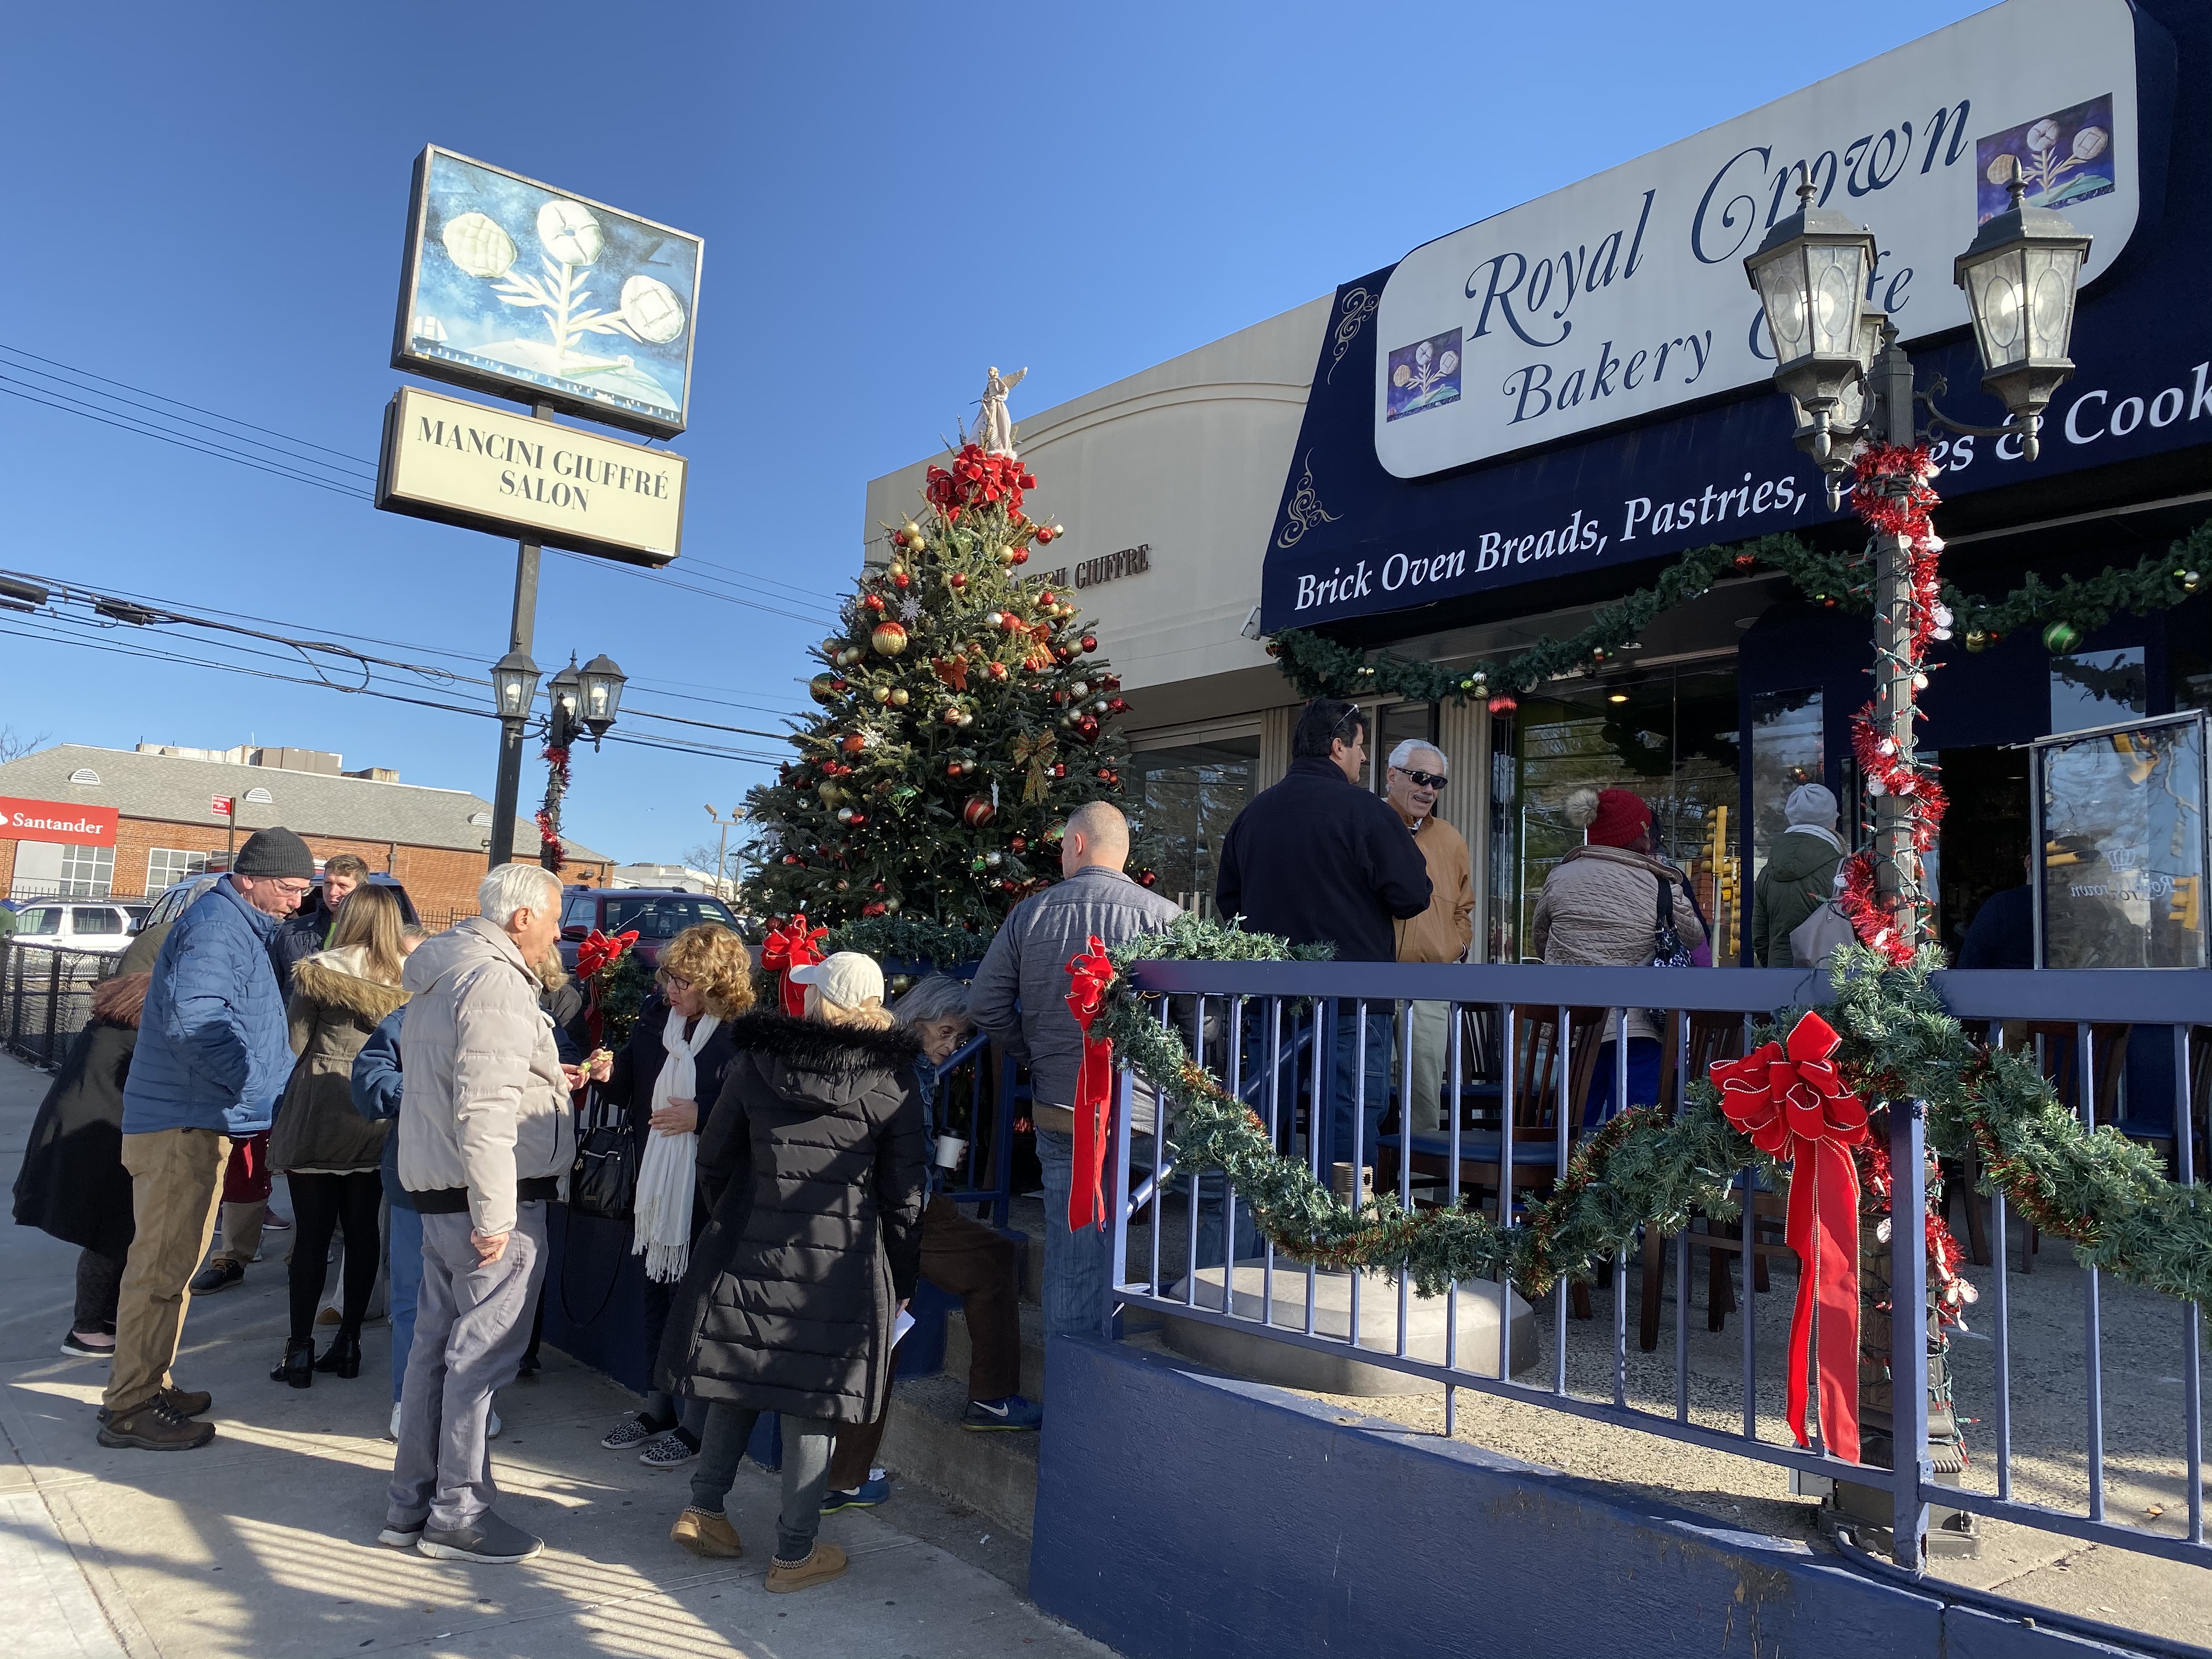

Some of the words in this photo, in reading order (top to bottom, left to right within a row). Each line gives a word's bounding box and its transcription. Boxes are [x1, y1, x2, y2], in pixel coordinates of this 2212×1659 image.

[1465, 188, 1656, 347] Royal
[1503, 329, 1712, 426] Bakery
[417, 416, 545, 470] MANCINI
[553, 450, 669, 500] GIUFFRÉ
[499, 470, 590, 512] SALON
[1294, 561, 1373, 611] Brick
[1381, 548, 1466, 591] Oven
[1475, 509, 1611, 573] Breads,
[1620, 472, 1808, 542] Pastries,
[2064, 361, 2212, 444] Cook
[1074, 543, 1149, 589] GIUFFRE
[12, 812, 104, 834] Santander
